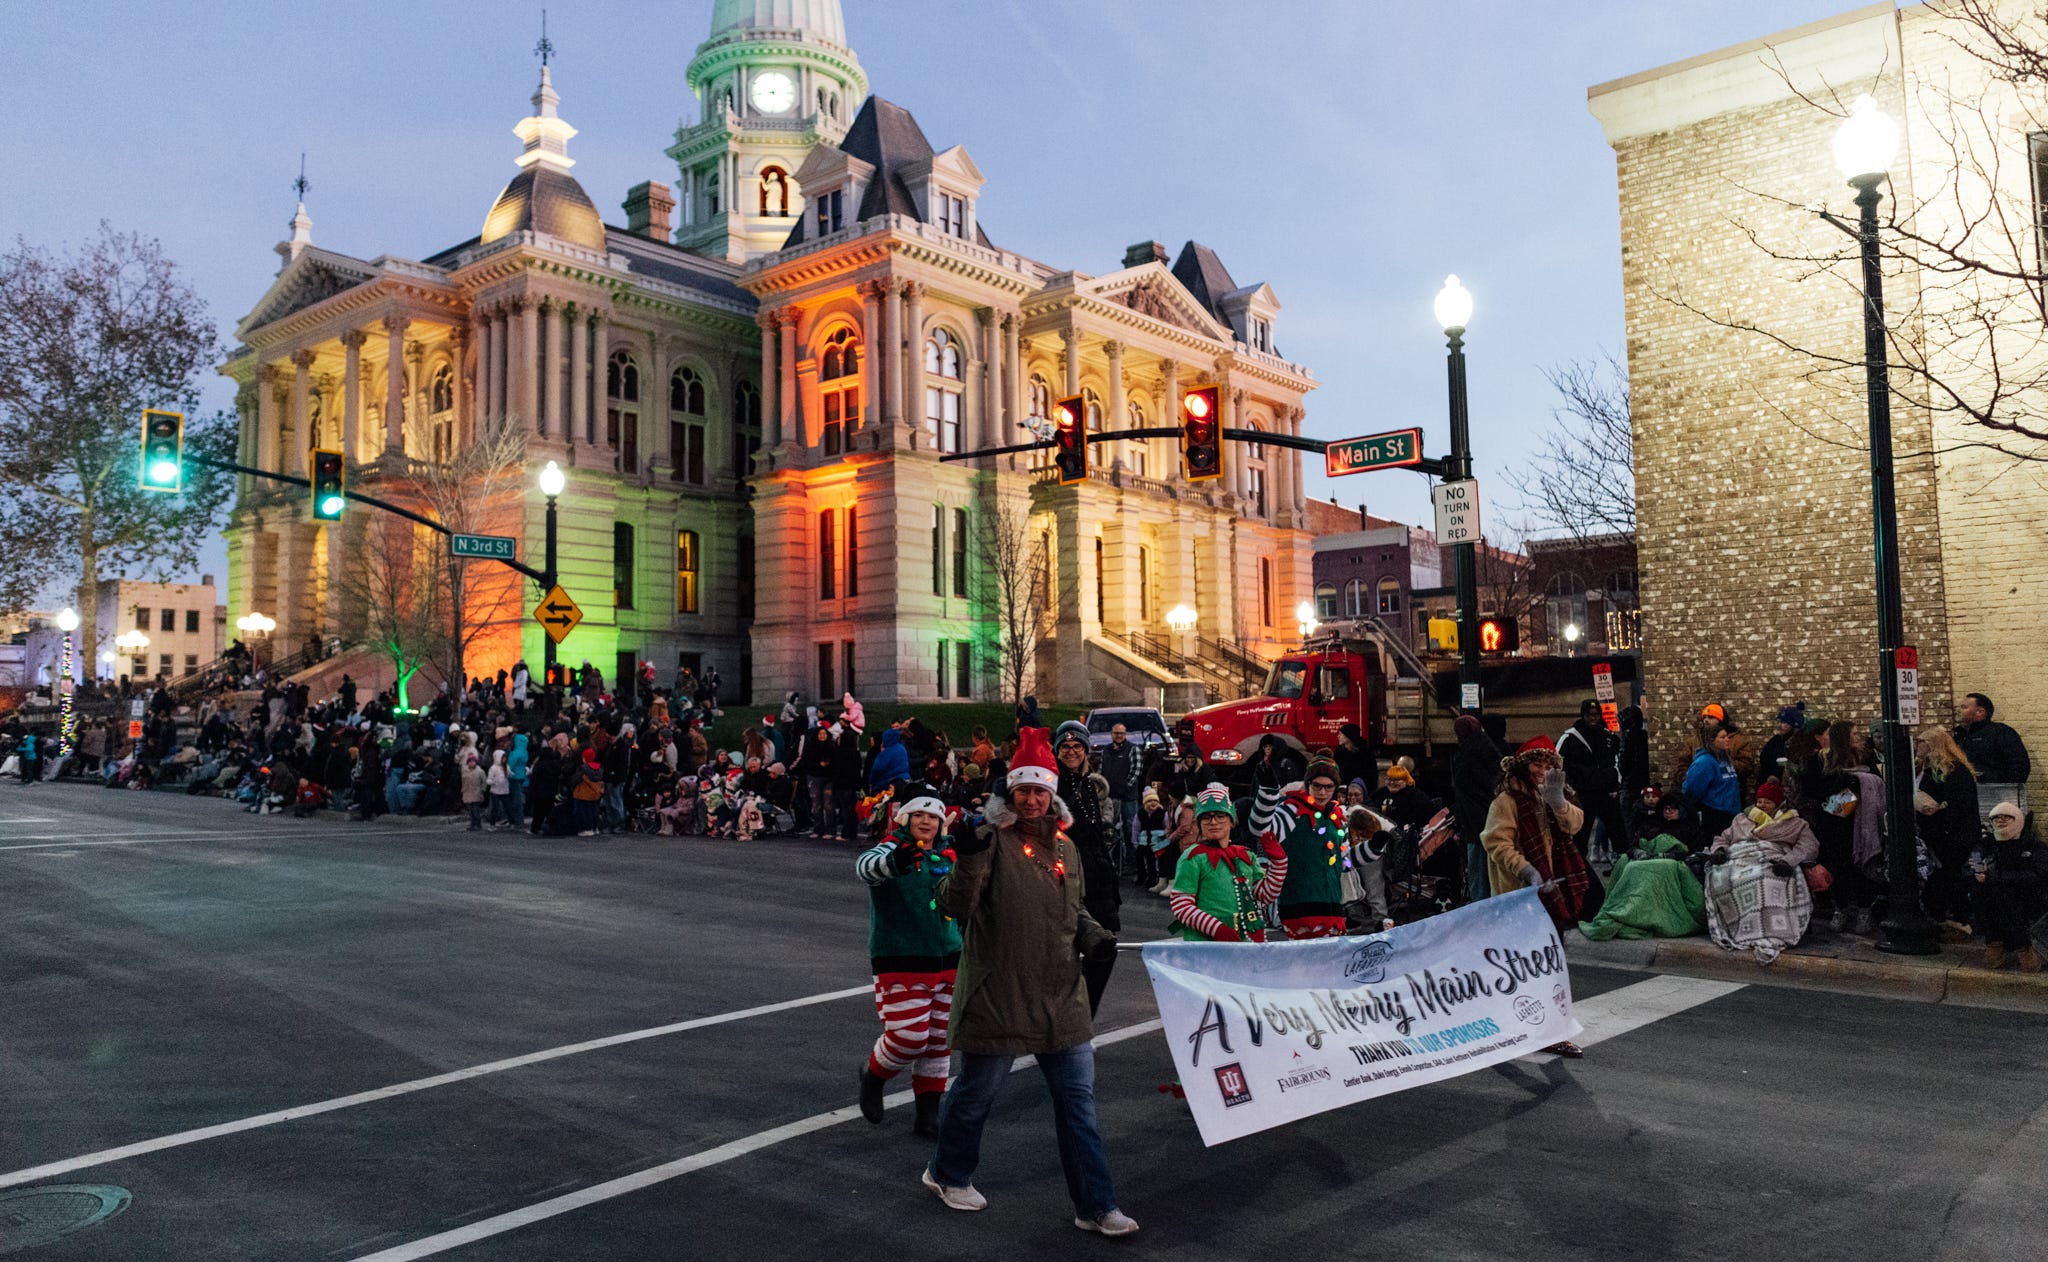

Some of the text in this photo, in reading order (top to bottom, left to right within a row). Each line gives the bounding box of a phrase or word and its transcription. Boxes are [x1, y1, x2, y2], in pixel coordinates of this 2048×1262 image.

[1339, 438, 1405, 465] Main St
[1446, 487, 1465, 501] NO
[1444, 502, 1470, 514] TURN
[1450, 515, 1464, 526] ON
[1448, 529, 1467, 539] RED
[458, 538, 509, 554] N 3rd St
[1900, 651, 1912, 664] LZ
[1902, 671, 1913, 683] 30
[1188, 933, 1564, 1067] A Very Merry Main Street
[1348, 1041, 1393, 1065] THANK
[1386, 1039, 1413, 1059] YOU
[1404, 1037, 1425, 1055] TO
[1418, 1034, 1446, 1053] OUR
